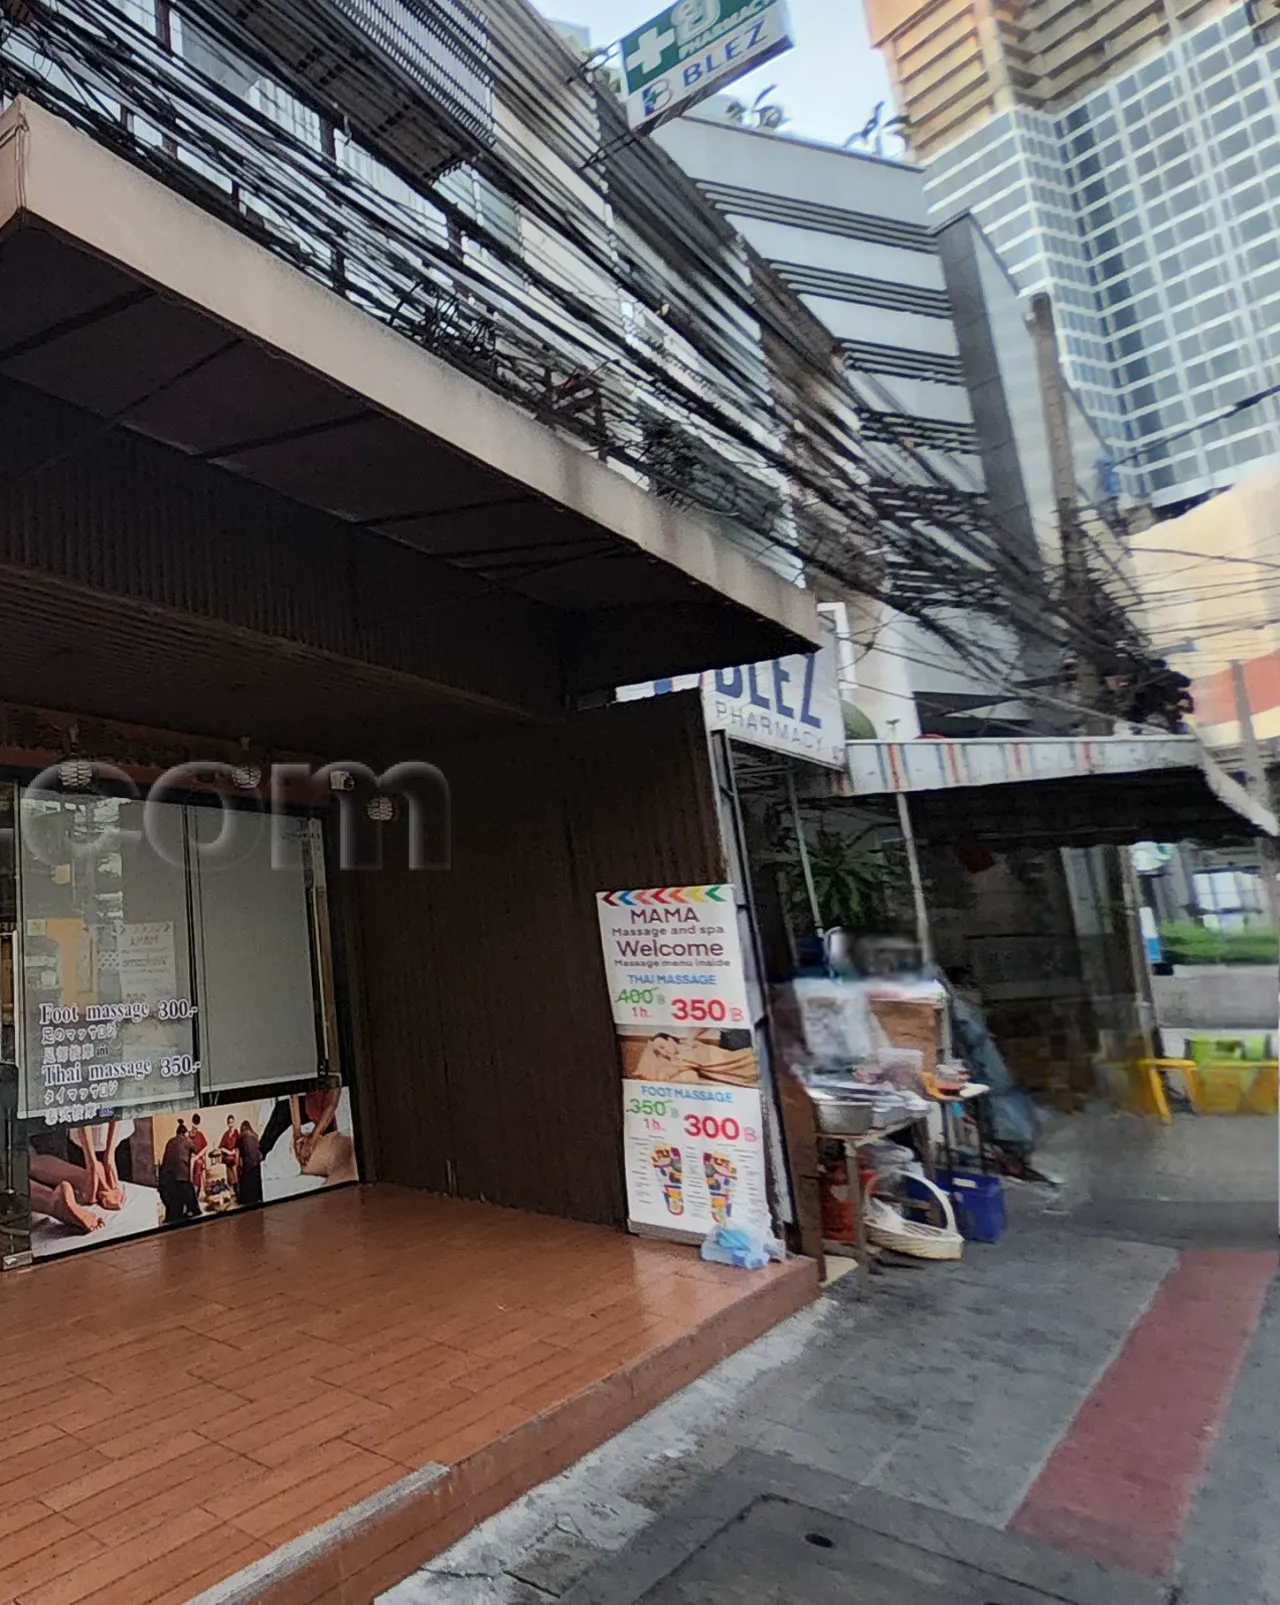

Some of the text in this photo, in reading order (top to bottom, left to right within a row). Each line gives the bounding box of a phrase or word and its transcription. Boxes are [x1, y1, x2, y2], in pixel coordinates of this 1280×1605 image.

[682, 16, 769, 88] BLEZ
[715, 700, 822, 750] PHARMACY
[630, 907, 701, 925] MAMA
[612, 925, 726, 938] Massage and spa
[616, 939, 724, 957] Welcome
[614, 960, 660, 969] Massage
[695, 959, 731, 967] inside
[628, 974, 718, 985] THAI MASSAGE
[39, 1003, 79, 1025] Foot
[85, 1001, 150, 1022] massage
[671, 998, 726, 1021] 350
[42, 1062, 82, 1087] Thai
[88, 1058, 152, 1081] massage
[641, 1085, 734, 1103] FOOT MASSAGE
[627, 1098, 667, 1116] 350
[683, 1113, 740, 1141] 300
